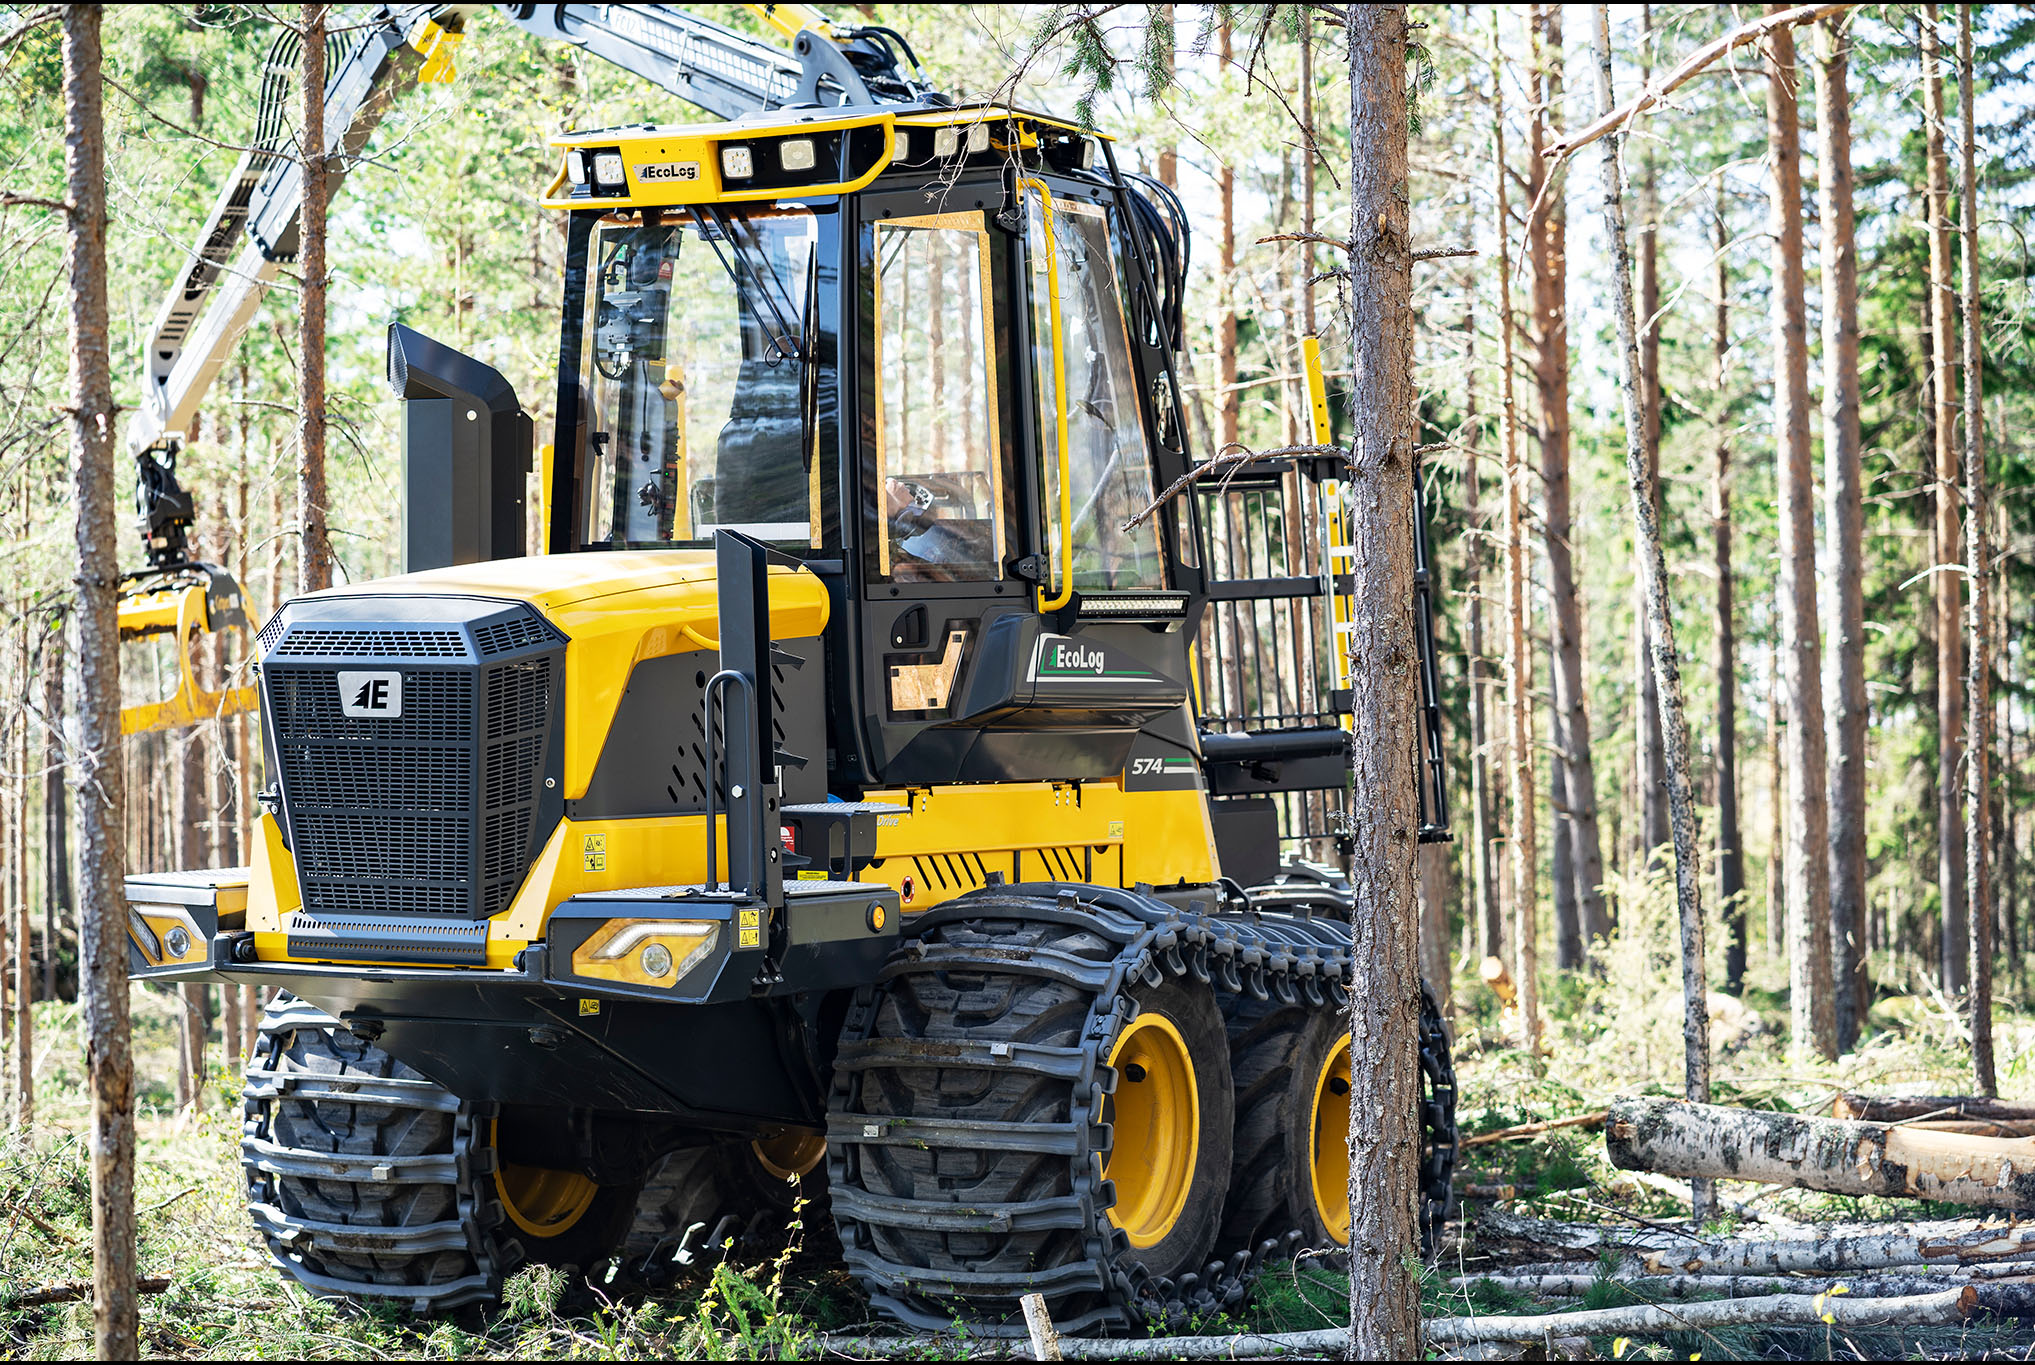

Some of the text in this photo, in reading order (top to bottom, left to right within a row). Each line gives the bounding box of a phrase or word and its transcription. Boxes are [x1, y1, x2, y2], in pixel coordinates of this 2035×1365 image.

[647, 164, 696, 180] EcoLog
[1056, 644, 1104, 675] EcoLog
[1131, 758, 1163, 775] 574
